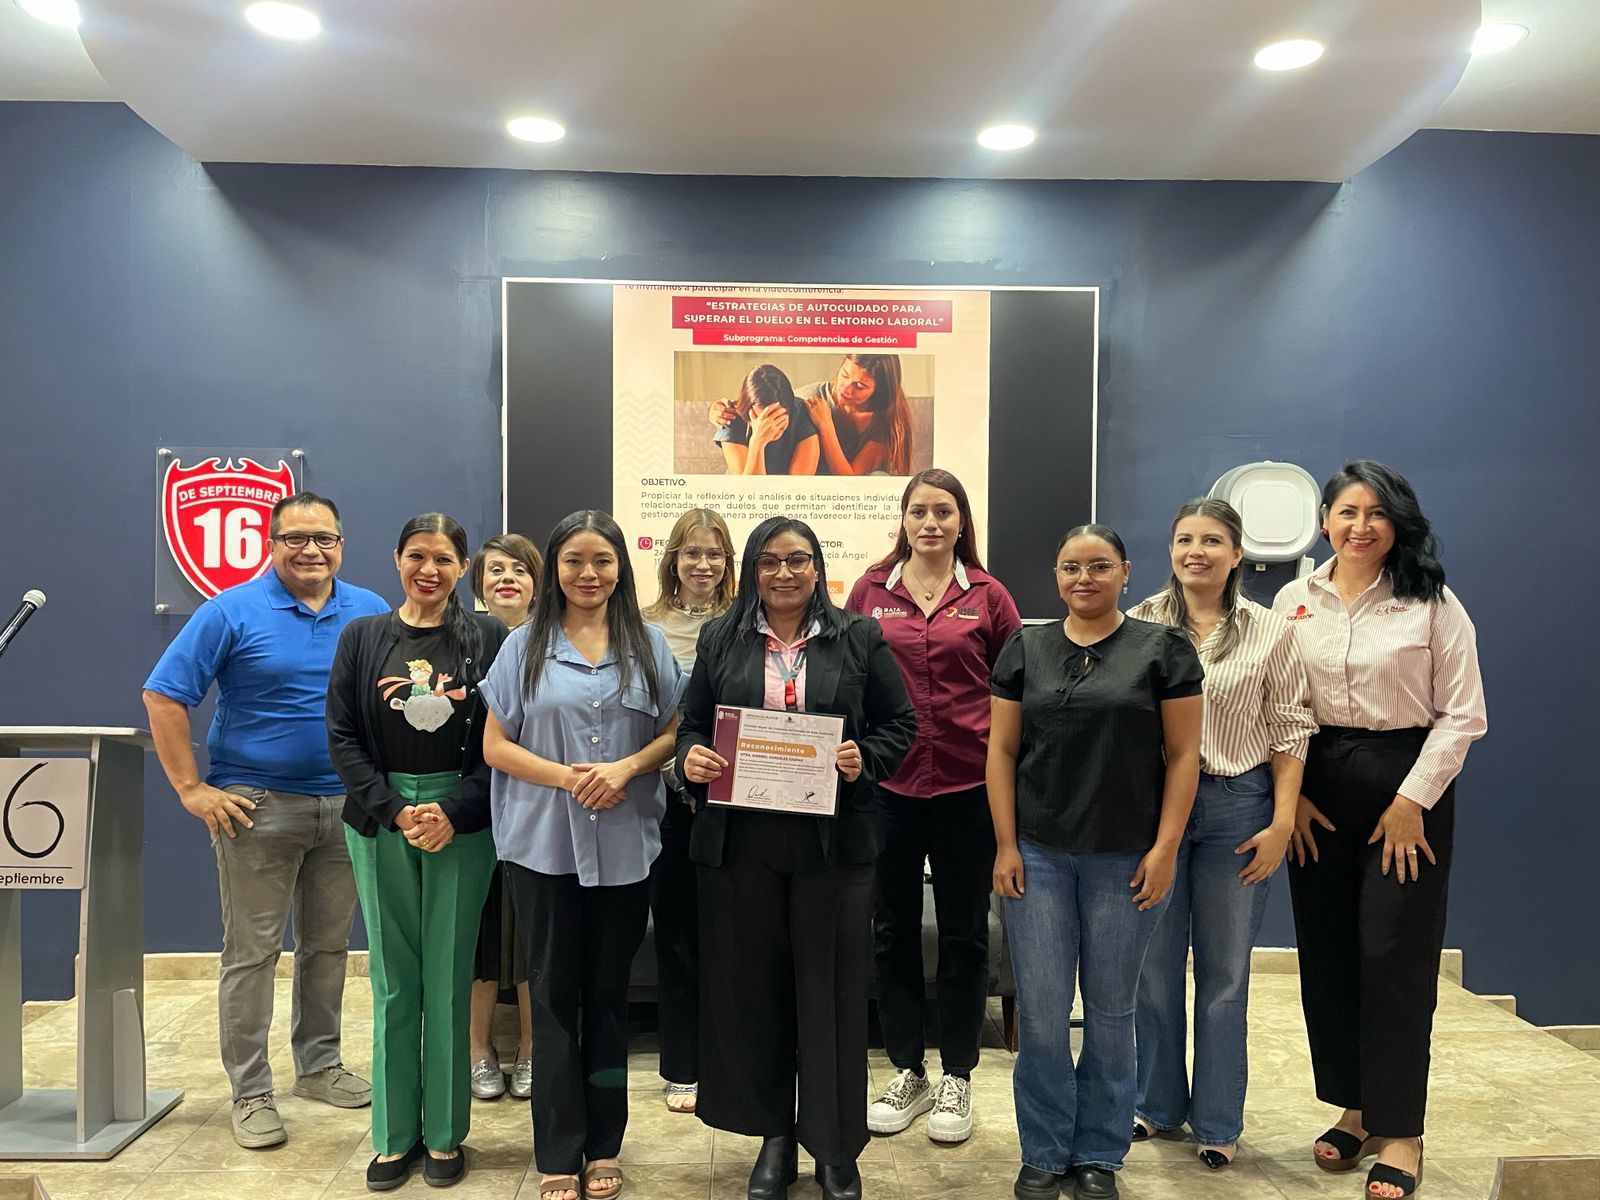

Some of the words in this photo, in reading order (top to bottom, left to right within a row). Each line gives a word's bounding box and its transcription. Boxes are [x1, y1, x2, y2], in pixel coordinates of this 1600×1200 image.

[706, 301, 786, 311] “ESTRATEGIAS
[788, 303, 804, 312] DE
[806, 303, 889, 313] AUTOCUIDADO
[892, 304, 922, 313] PARA
[683, 314, 736, 323] SUPERAR
[739, 315, 752, 324] EL
[755, 315, 793, 324] DUELO
[796, 316, 811, 325] EN
[814, 316, 828, 325] EL
[831, 316, 884, 326] ENTORNO
[723, 333, 786, 343] Subprograma:
[787, 334, 850, 344] Competencias
[851, 336, 864, 344] de
[864, 335, 898, 344] Gestión
[641, 478, 687, 486] OBJETIVO:
[178, 488, 197, 502] DE
[199, 485, 281, 503] SEPTIEMBRE
[641, 491, 682, 501] Propiciar
[685, 491, 693, 500] la
[696, 491, 736, 501] reflexión
[739, 493, 745, 502] y
[747, 492, 756, 501] el
[759, 492, 792, 501] análisis
[795, 492, 807, 501] de
[810, 493, 860, 502] situaciones
[641, 501, 698, 509] relacionadas
[726, 502, 756, 510] duelos
[762, 503, 780, 512] que
[785, 502, 826, 512] permitan
[832, 502, 878, 511] identificar
[883, 503, 891, 511] la
[641, 510, 687, 520] gestionar
[809, 512, 852, 520] favorecer
[854, 512, 867, 520] las
[868, 512, 903, 521] relacion
[193, 507, 263, 570] 16
[655, 539, 670, 547] FEC
[819, 540, 845, 549] CTOR:
[841, 549, 868, 561] Ángel
[740, 741, 805, 754] Reconocimiento
